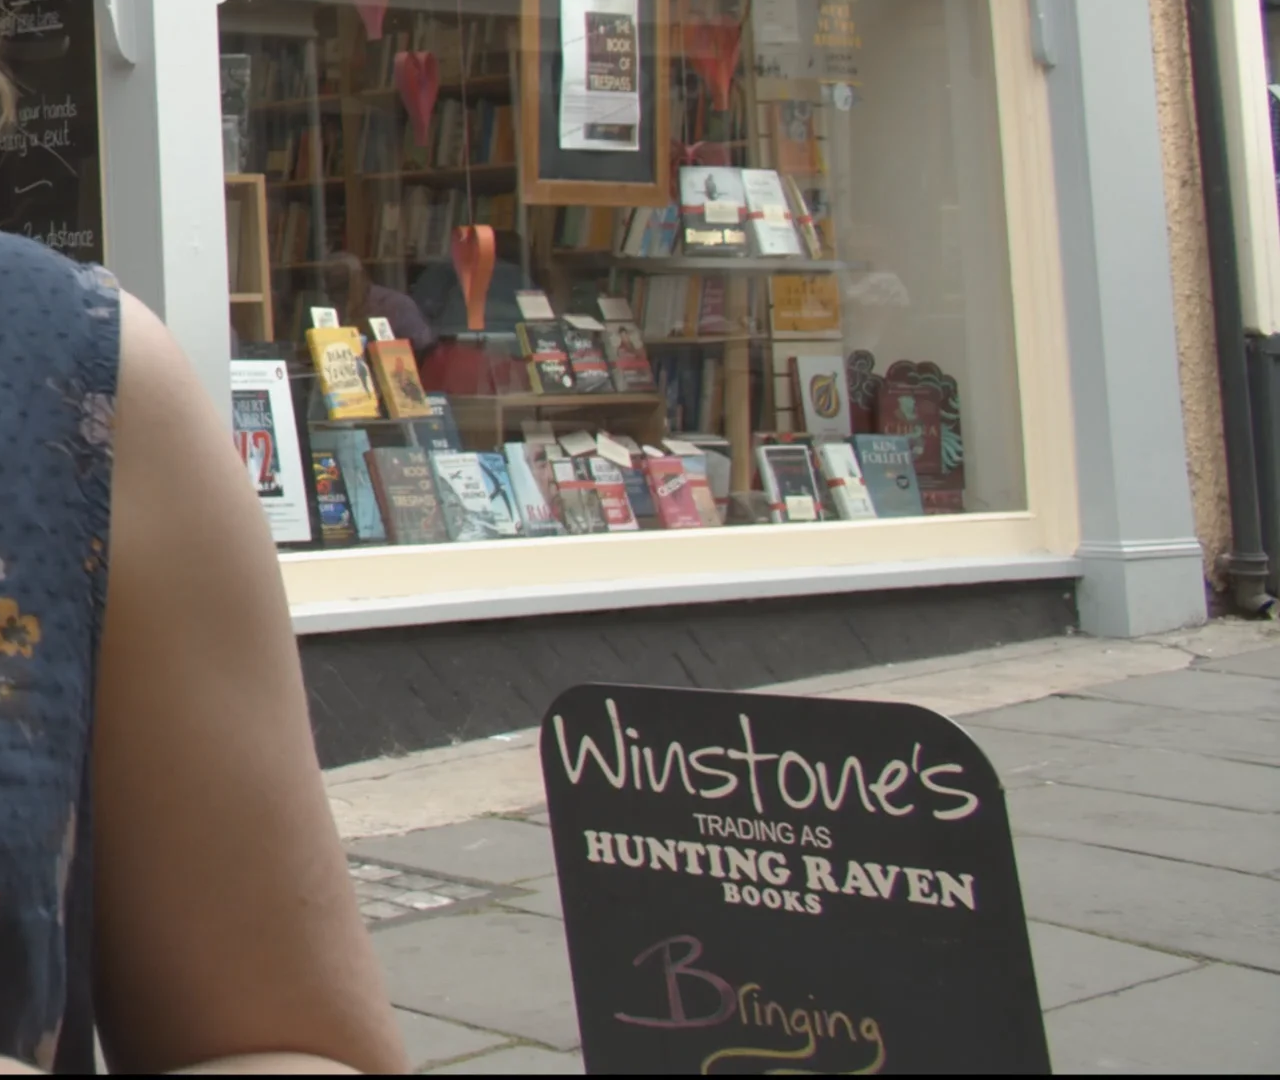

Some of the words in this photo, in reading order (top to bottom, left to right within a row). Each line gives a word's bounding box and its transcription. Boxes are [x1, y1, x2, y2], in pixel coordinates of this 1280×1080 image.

[861, 451, 910, 465] FOLLETT
[553, 698, 979, 821] Winstone's
[693, 813, 795, 846] TRADING
[800, 824, 833, 848] AS
[583, 830, 792, 886] HUNTING
[801, 855, 976, 911] RAVEN
[723, 881, 822, 915] BOOKS
[614, 934, 887, 1074] Bringing
